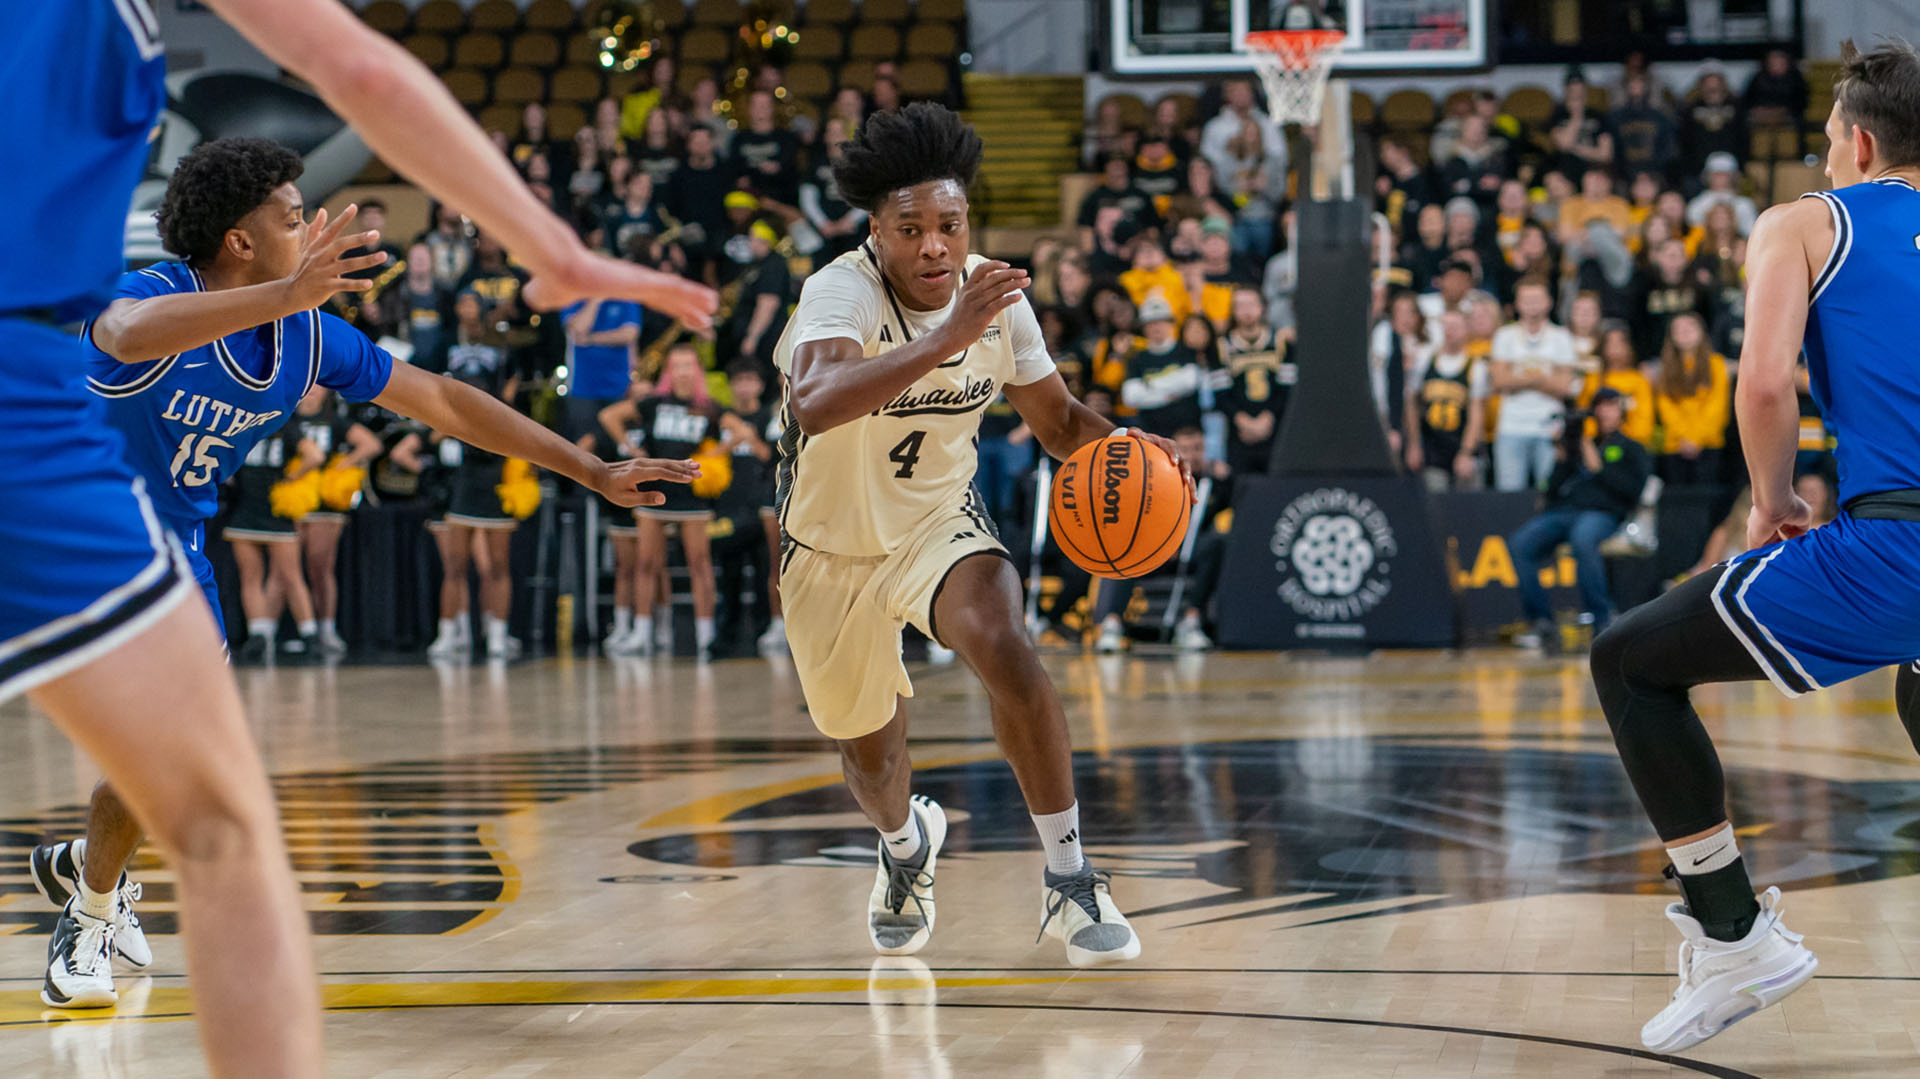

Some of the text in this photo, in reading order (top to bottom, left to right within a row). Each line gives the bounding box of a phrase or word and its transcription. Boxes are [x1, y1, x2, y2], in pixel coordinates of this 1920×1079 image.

[871, 375, 994, 417] ilwaukee
[170, 433, 235, 488] 15
[888, 430, 927, 479] 4
[1062, 461, 1078, 510] EVO
[1103, 441, 1132, 525] Wilson
